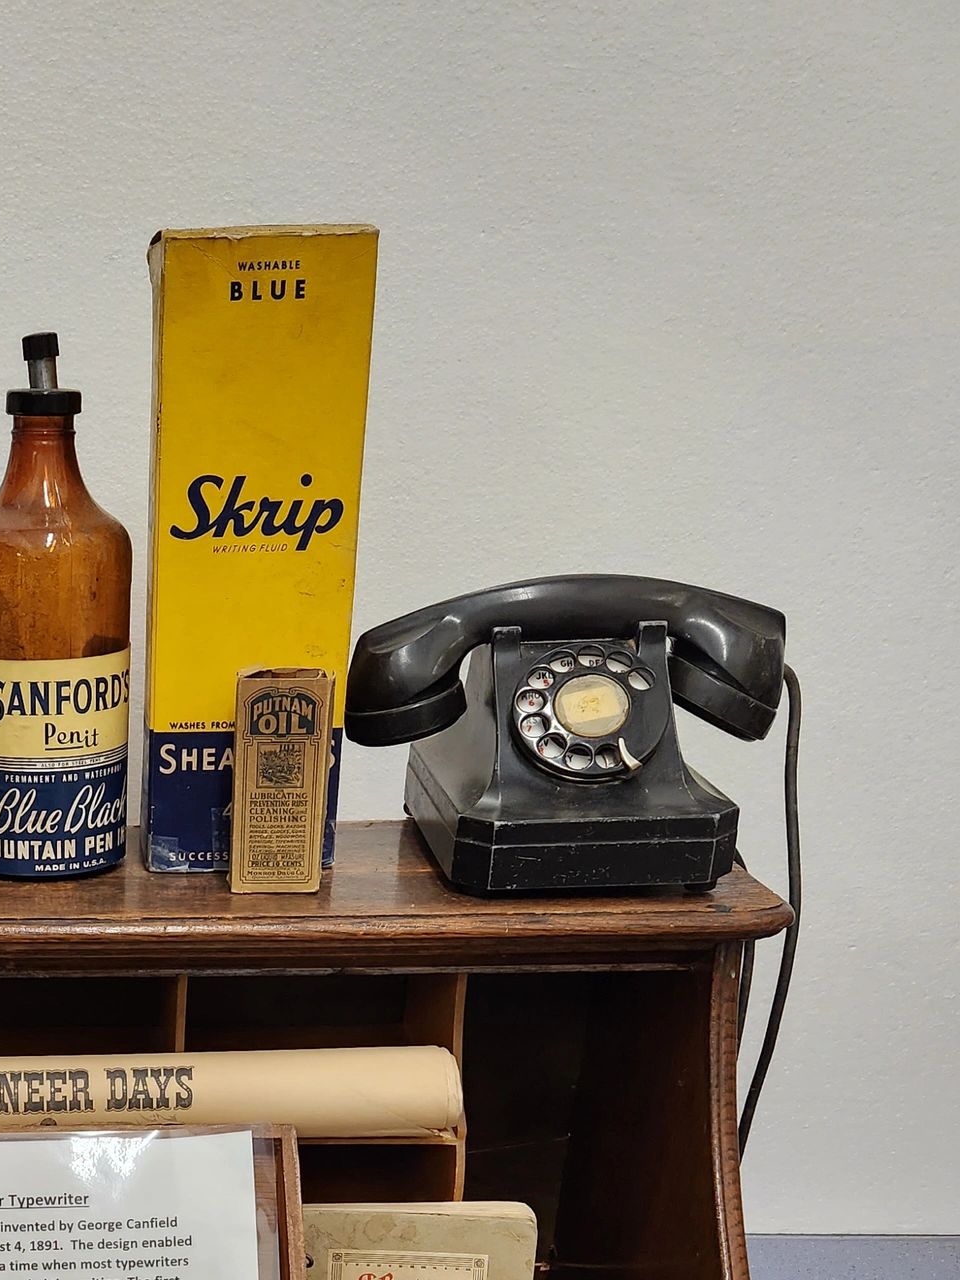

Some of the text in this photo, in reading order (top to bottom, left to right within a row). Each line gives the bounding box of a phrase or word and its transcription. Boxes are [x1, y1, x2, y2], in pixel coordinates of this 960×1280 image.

[238, 260, 301, 271] WASHABLE
[229, 279, 306, 301] BLUE
[170, 474, 344, 551] Skrip
[212, 544, 288, 553] WRITING FLUID
[253, 696, 313, 721] PUTNAM
[169, 721, 236, 730] WASHES FROM
[258, 712, 306, 734] OIL
[44, 723, 99, 748] Penit
[5, 774, 55, 783] PERMANENT
[62, 773, 79, 782] AND
[85, 831, 113, 856] PEN
[35, 864, 65, 872] MADE
[84, 859, 107, 869] U.S.A.
[169, 851, 230, 862] SUCCESS
[104, 1066, 194, 1113] DAYS
[7, 1193, 90, 1208] Typewriter
[0, 1219, 56, 1233] invented
[59, 1219, 74, 1234] by
[77, 1219, 123, 1233] George
[126, 1215, 178, 1230] Canfield
[13, 1240, 26, 1254] 4,
[29, 1239, 64, 1252] 1891.
[69, 1238, 94, 1251] The
[97, 1237, 138, 1252] design
[141, 1234, 193, 1249] enabled
